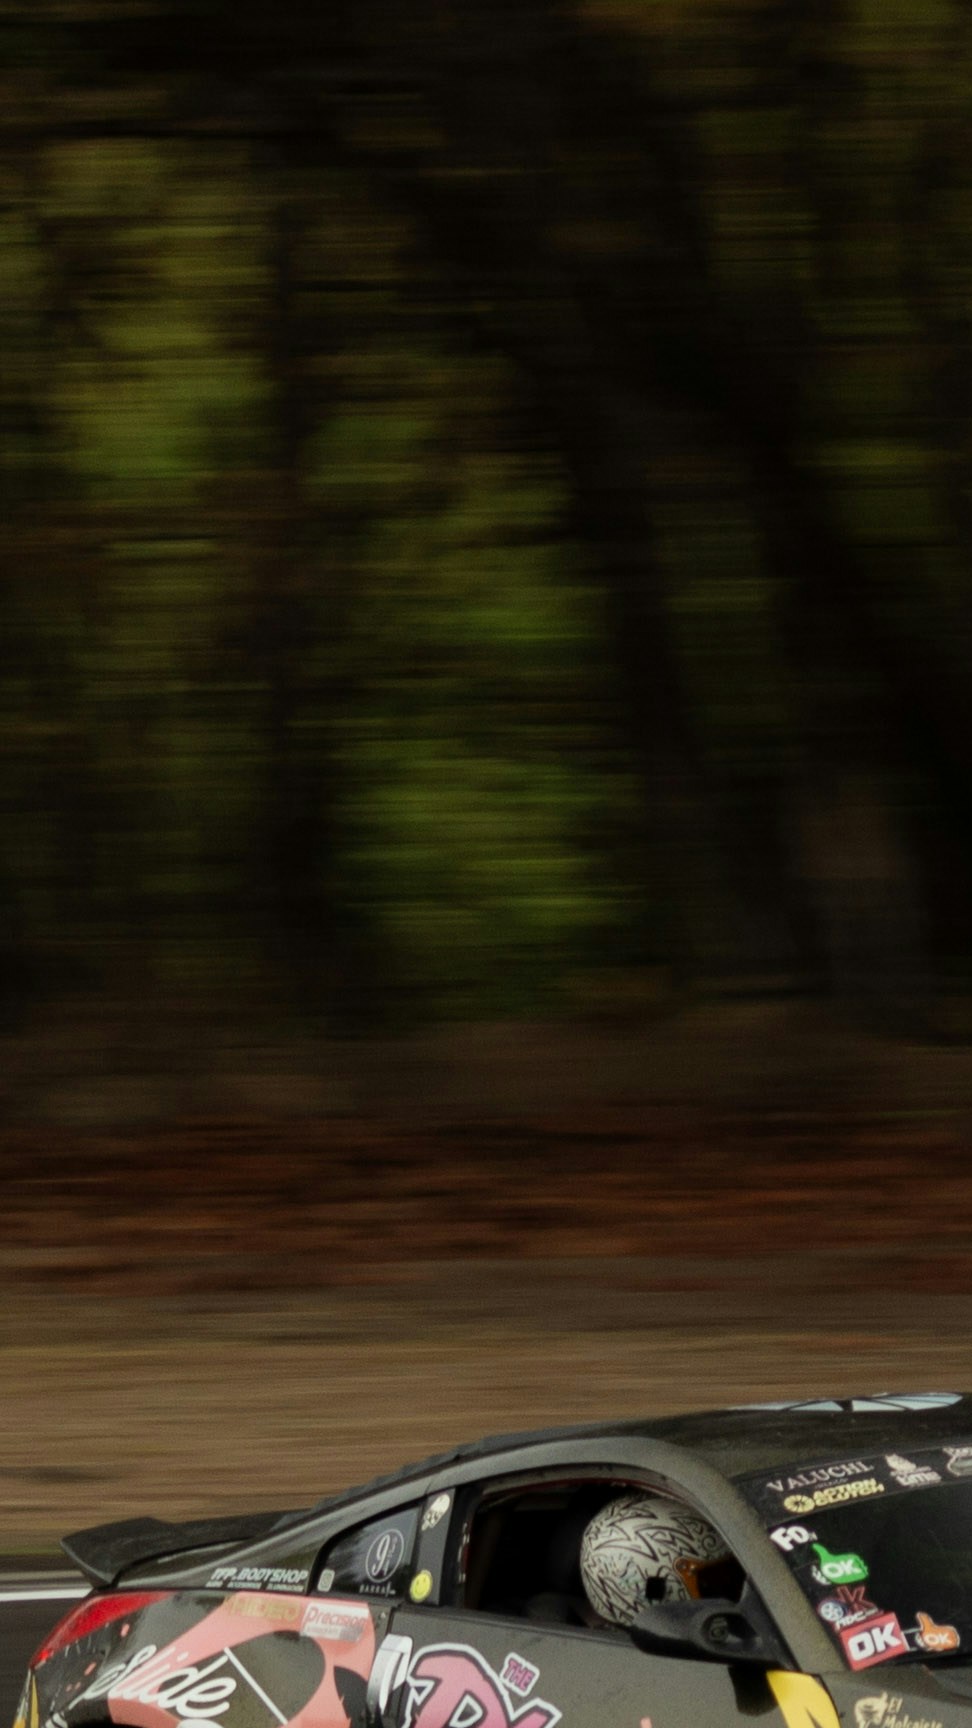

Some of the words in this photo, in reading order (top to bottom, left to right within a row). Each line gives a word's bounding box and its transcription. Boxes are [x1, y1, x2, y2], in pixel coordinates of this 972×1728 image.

[813, 1478, 877, 1499] ACTION
[815, 1484, 885, 1507] CLUTCH
[821, 1558, 863, 1578] OK
[848, 1622, 902, 1660] OK
[924, 1632, 953, 1645] OK
[503, 1658, 536, 1691] THE
[887, 1697, 903, 1714] El
